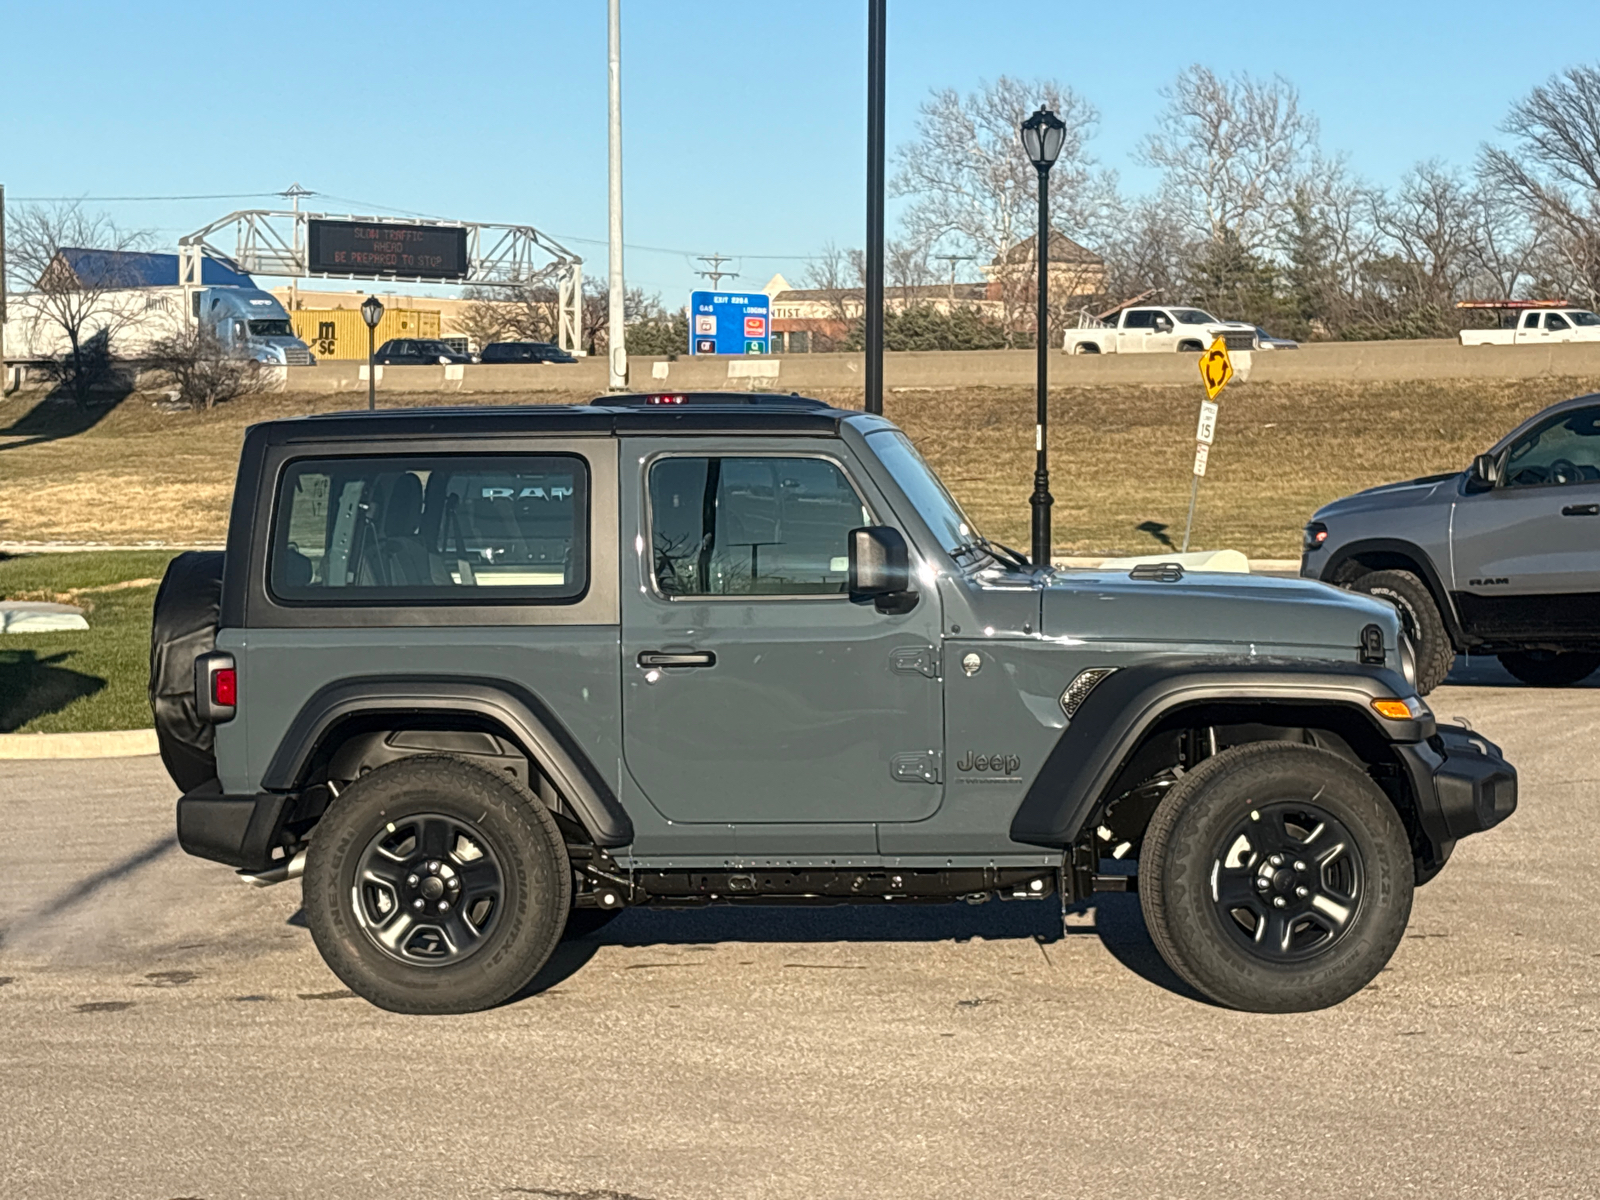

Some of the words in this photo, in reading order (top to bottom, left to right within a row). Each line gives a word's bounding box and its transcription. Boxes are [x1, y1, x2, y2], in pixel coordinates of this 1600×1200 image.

[354, 227, 379, 239] SLOW
[384, 229, 424, 241] TRAFFIC
[373, 241, 403, 252] AHEAD
[334, 251, 347, 263] BE
[351, 252, 397, 265] PREPARED
[402, 254, 414, 266] TO
[418, 255, 442, 267] STOP
[713, 296, 729, 304] EXIT
[699, 305, 714, 313] GAS
[743, 307, 767, 315] LODGING
[1201, 423, 1211, 439] 15
[1469, 577, 1510, 586] RAM
[957, 750, 1021, 775] Jeep
[328, 837, 350, 926] NEXEN
